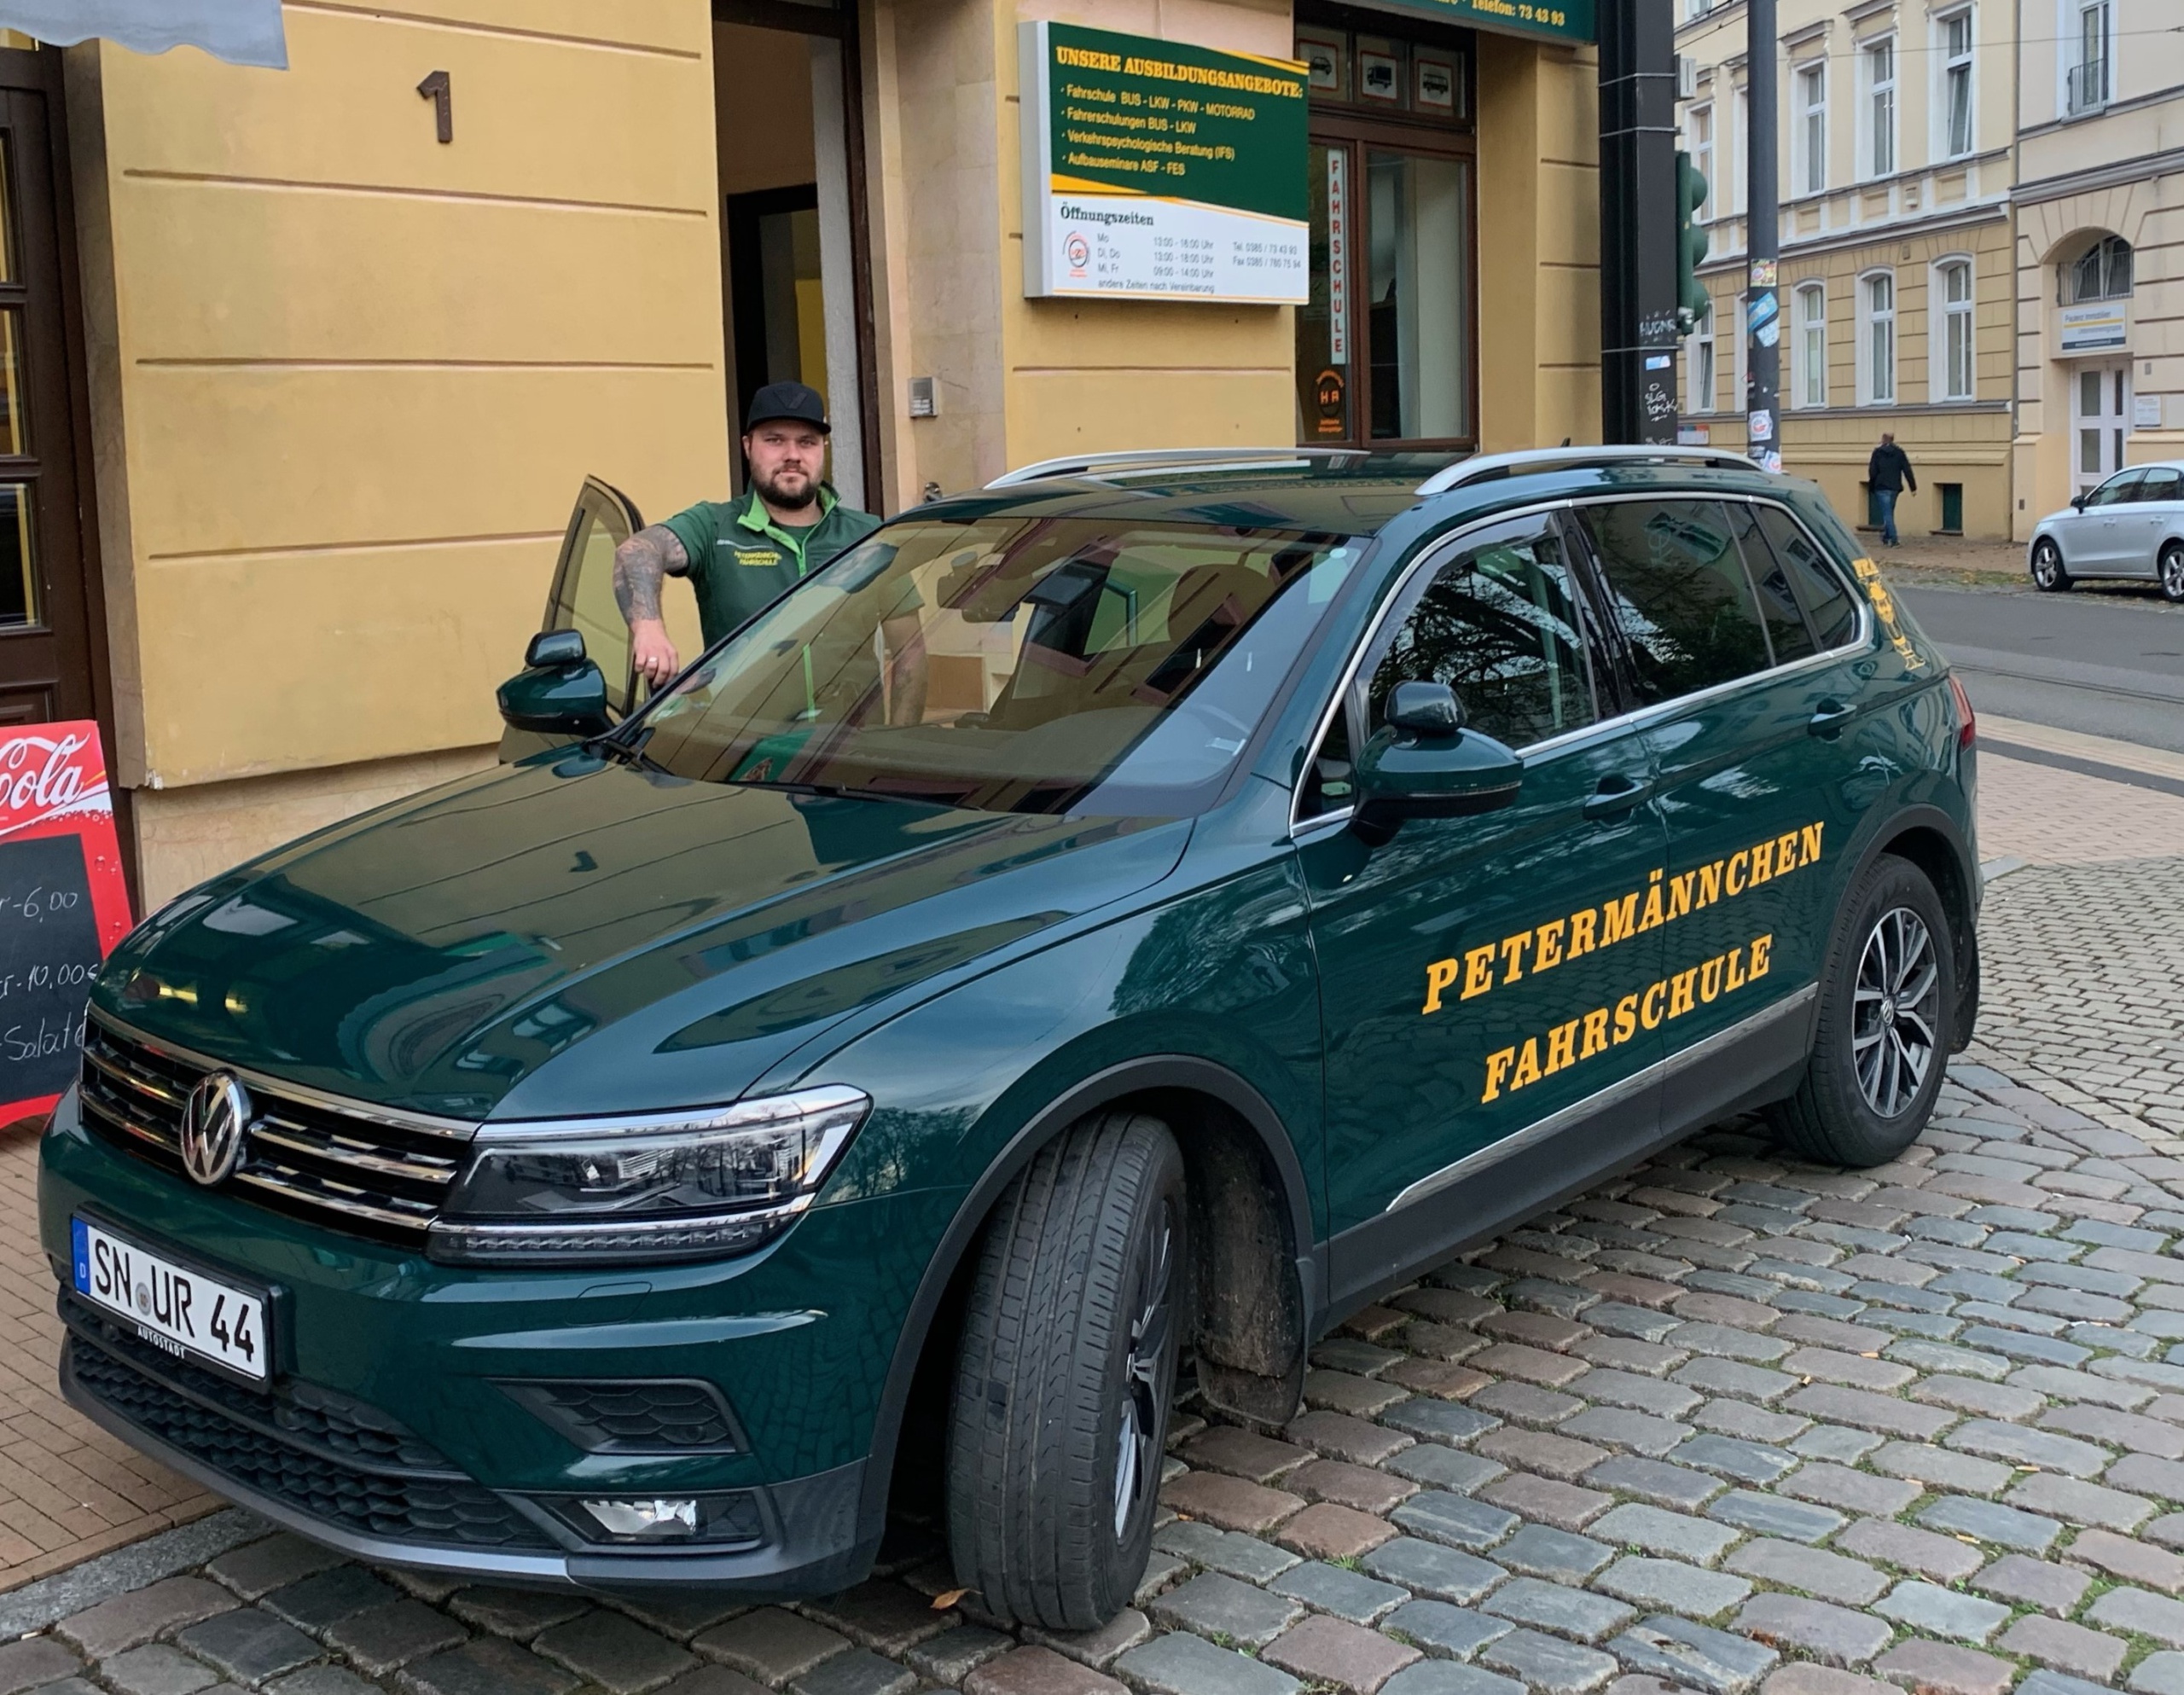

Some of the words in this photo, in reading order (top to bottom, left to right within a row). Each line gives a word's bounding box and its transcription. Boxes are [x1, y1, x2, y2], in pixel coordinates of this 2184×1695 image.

[1519, 4, 1532, 20] 73
[1535, 8, 1549, 22] 43
[1551, 11, 1565, 26] 93
[1056, 46, 1121, 72] UNSERE
[1124, 57, 1303, 98] AUSBILDUNGSANGEBOTE:
[416, 70, 453, 144] 1
[1066, 84, 1116, 103] Fahrschule
[1121, 91, 1141, 106] BUS
[1149, 96, 1170, 109] LKW
[1177, 99, 1199, 113] PKW
[1205, 102, 1255, 120] MOTORRAD
[1067, 107, 1146, 130] Fahrerschulungen
[1147, 117, 1168, 131] BUS
[1176, 120, 1196, 134] LKW
[1067, 129, 1173, 153] Verkehrspsychologische
[1175, 141, 1213, 160] Beratung
[1215, 146, 1235, 161] (IFS)
[1068, 152, 1138, 171] Aufbauseminare
[1141, 159, 1159, 173] ASF
[1166, 162, 1186, 176] FES
[1060, 201, 1154, 226] Öffnungszeiten
[1097, 233, 1109, 243] Mo
[1331, 160, 1343, 353] FAHRSCHULE
[1421, 821, 1825, 1015] PETERMÄNNCHEN
[1481, 933, 1773, 1104] FAHRSCHULE
[95, 1239, 132, 1308] SN
[151, 1264, 196, 1338] UR
[210, 1293, 255, 1363] 44
[137, 1326, 185, 1360] AUTOSTADT
